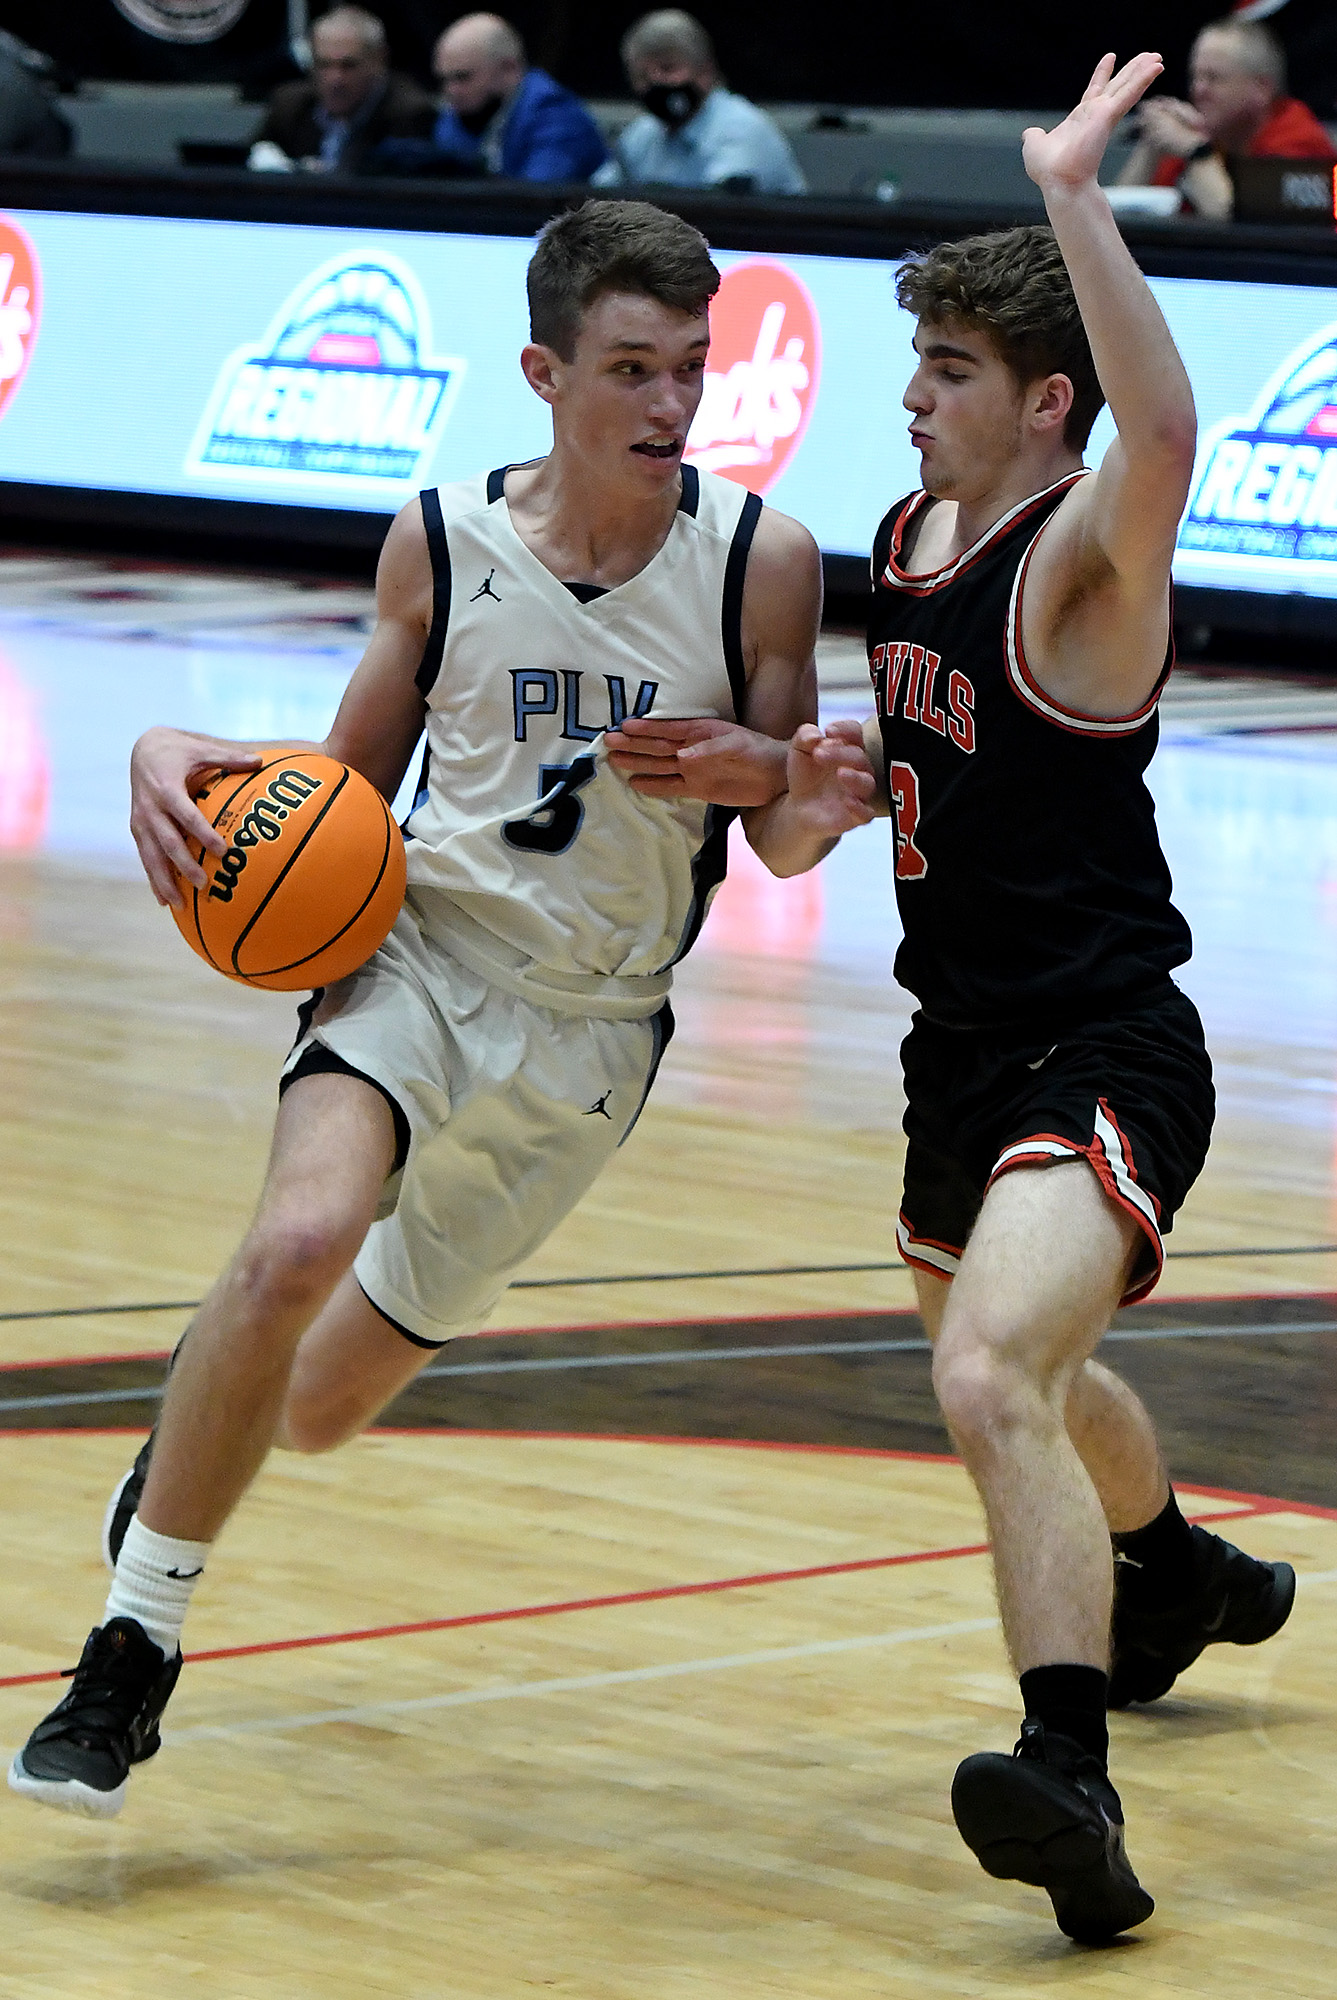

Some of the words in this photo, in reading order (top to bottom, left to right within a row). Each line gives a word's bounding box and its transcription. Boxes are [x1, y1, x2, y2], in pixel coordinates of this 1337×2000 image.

[1192, 438, 1337, 528] REGI
[508, 667, 659, 743] PLV
[208, 769, 323, 903] Wilson
